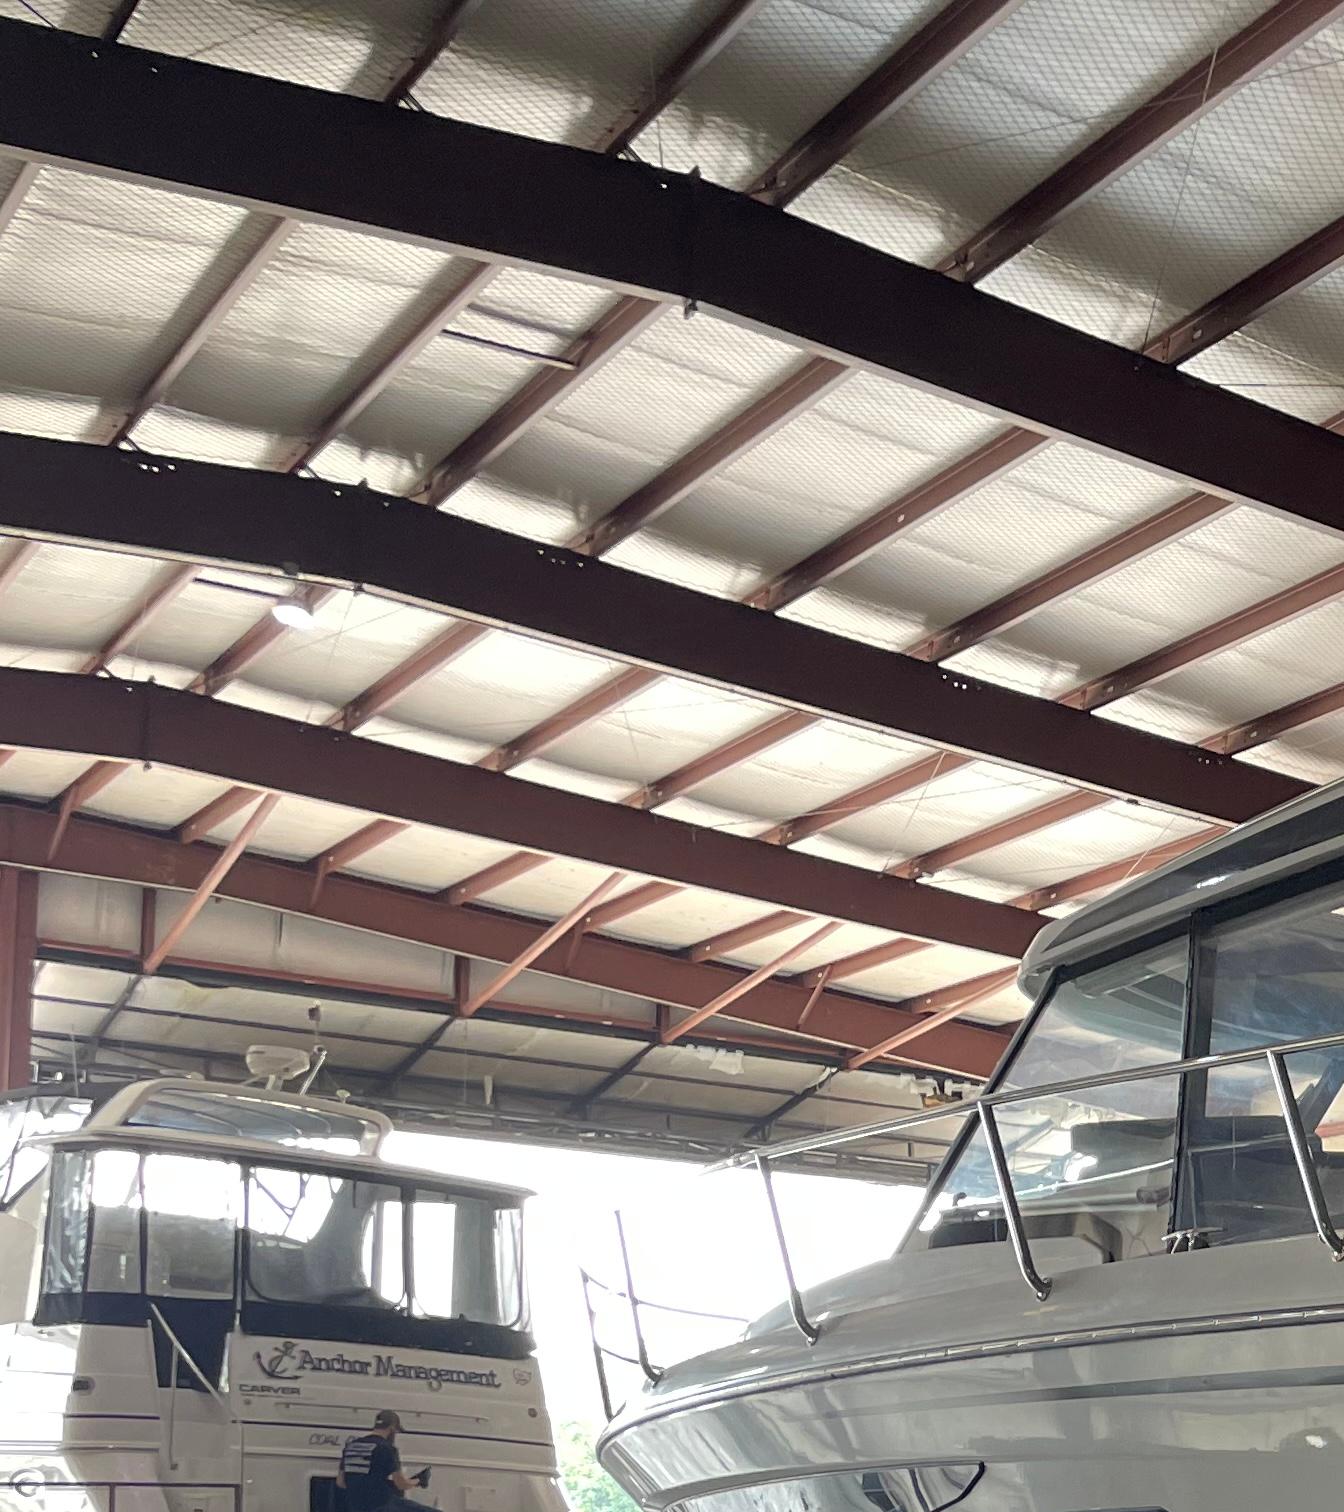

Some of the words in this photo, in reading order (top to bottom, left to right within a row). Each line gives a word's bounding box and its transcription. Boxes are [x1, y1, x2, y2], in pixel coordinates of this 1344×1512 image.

[299, 1349, 372, 1375] Anchor
[374, 1355, 501, 1391] Management
[239, 1384, 300, 1396] CARVER
